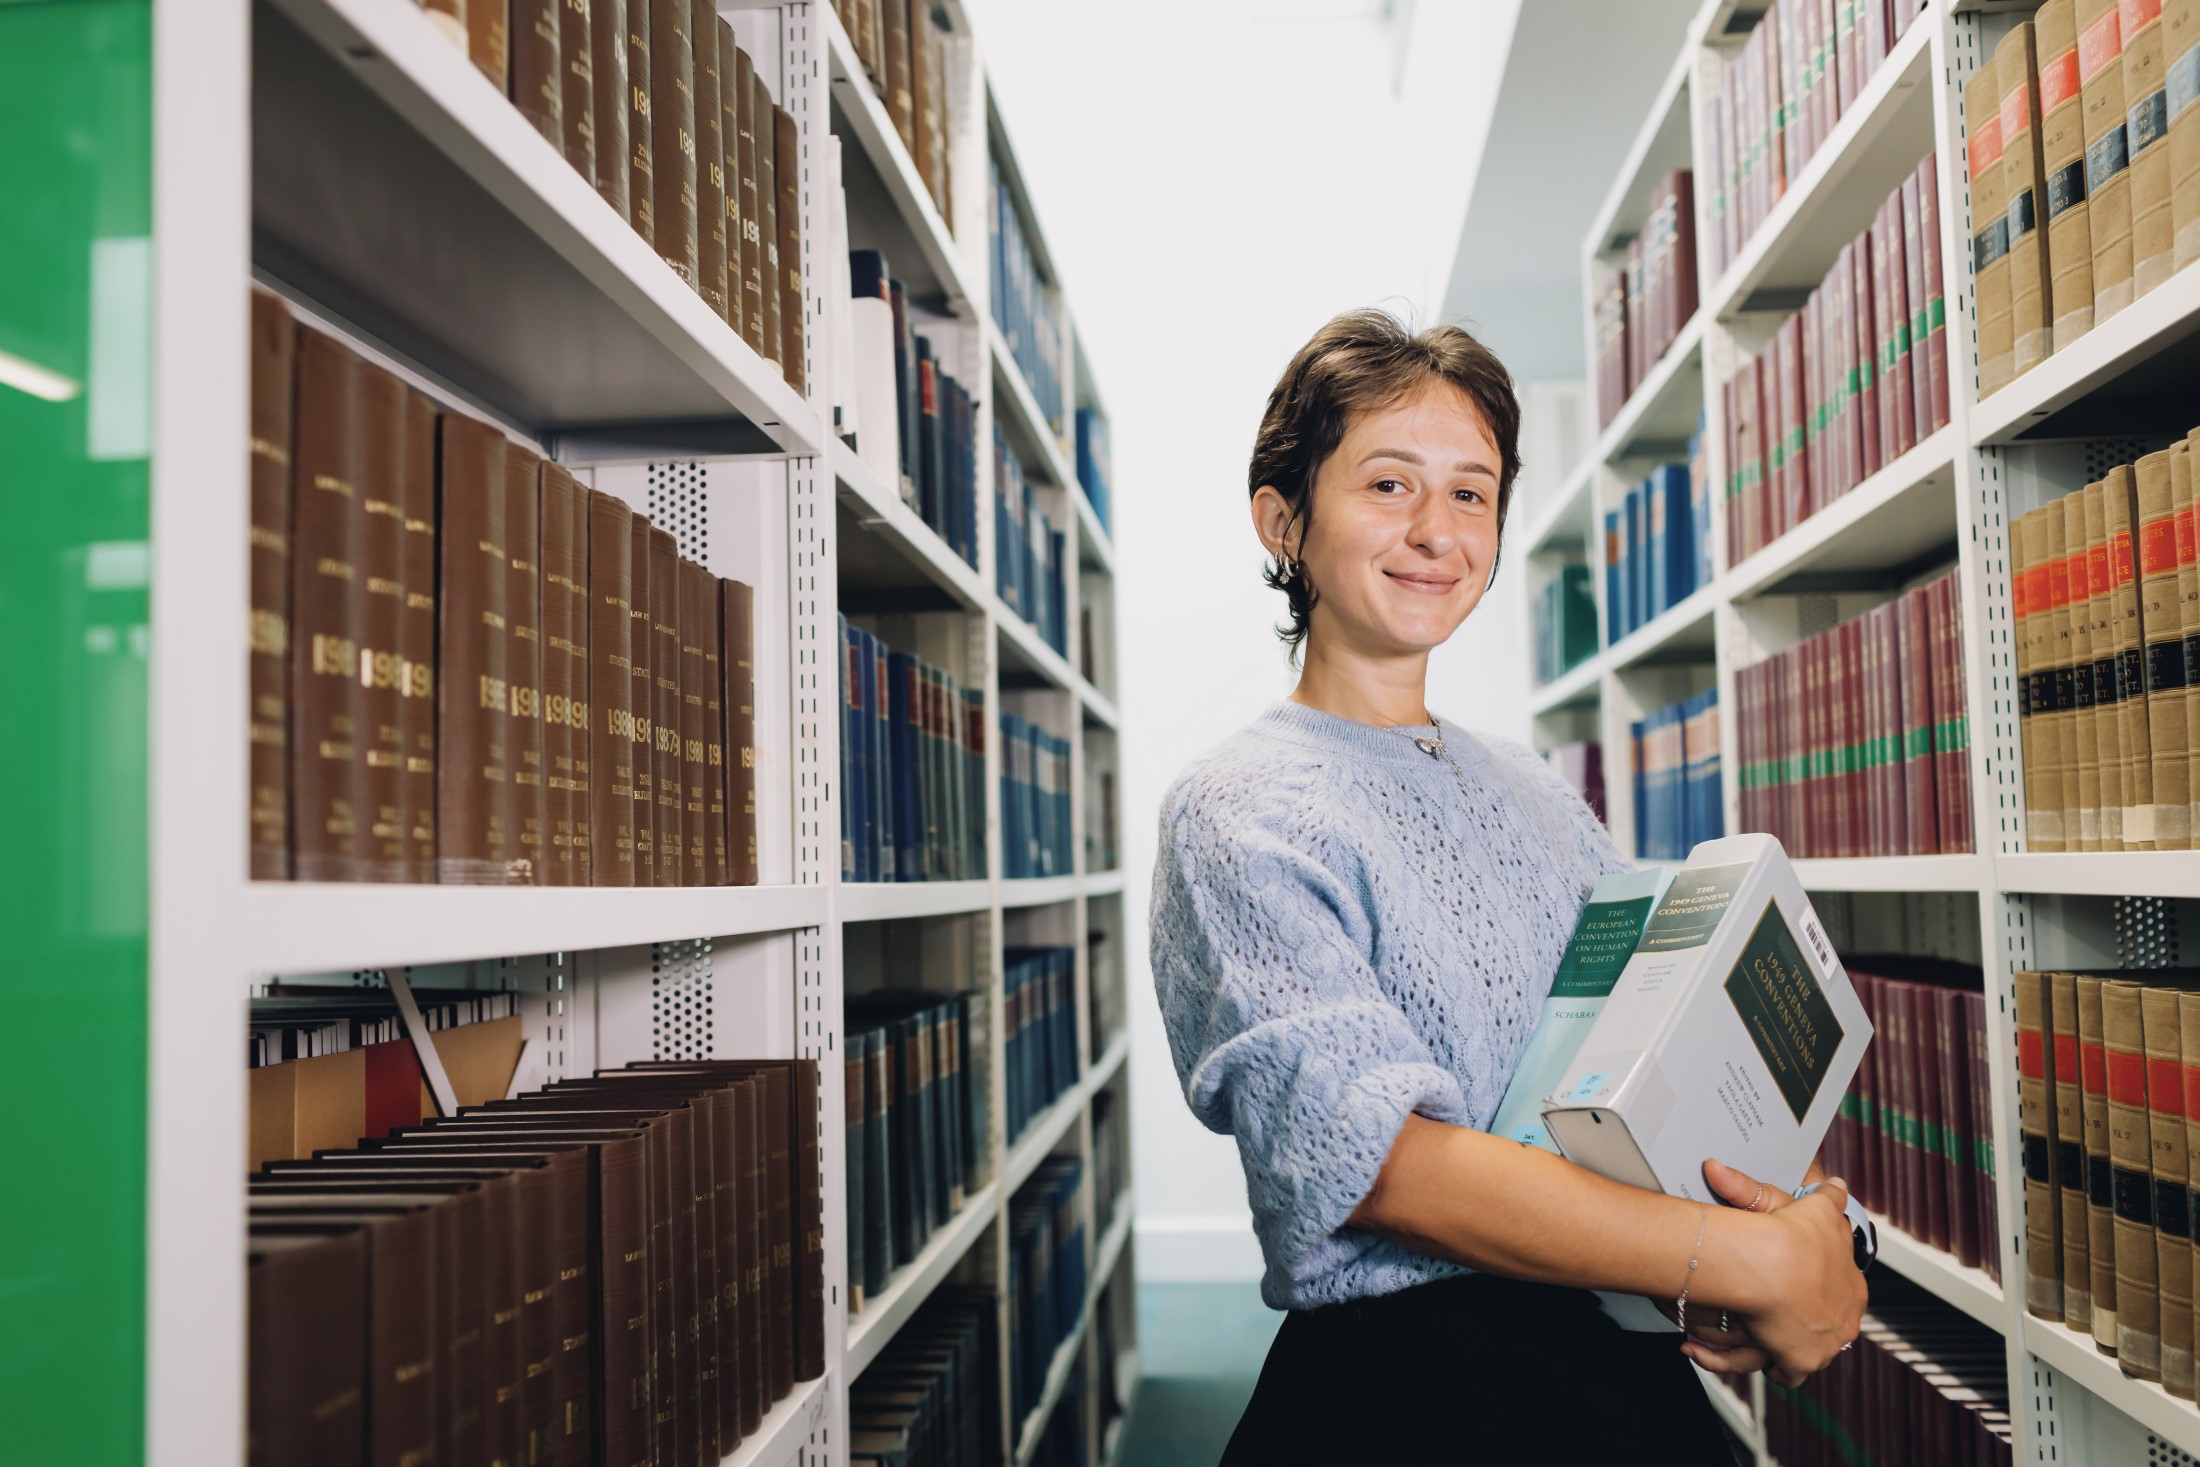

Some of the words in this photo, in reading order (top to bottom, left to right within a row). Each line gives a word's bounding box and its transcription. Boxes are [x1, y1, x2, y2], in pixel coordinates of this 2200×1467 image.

[679, 127, 696, 165] 198
[1695, 886, 1716, 894] THE
[1669, 898, 1690, 906] 1949
[1691, 892, 1730, 904] GENEVA
[1608, 909, 1627, 917] THE
[1658, 901, 1731, 916] CONVENTIONS
[1587, 919, 1636, 929] EUROPEAN
[1575, 929, 1639, 941] CONVENTION
[1656, 934, 1705, 944] COMMENTARY
[1576, 944, 1591, 952] ON
[1593, 942, 1628, 951] HUMAN
[1580, 955, 1615, 963] RIGHTS
[1792, 965, 1811, 1001] THE
[1767, 952, 1785, 983] 1949
[1784, 985, 1817, 1047] GENEVA
[1554, 1011, 1596, 1019] SCHABAS
[1754, 959, 1815, 1069] CONVENTIONS
[1757, 1020, 1787, 1072] COMMENTARY
